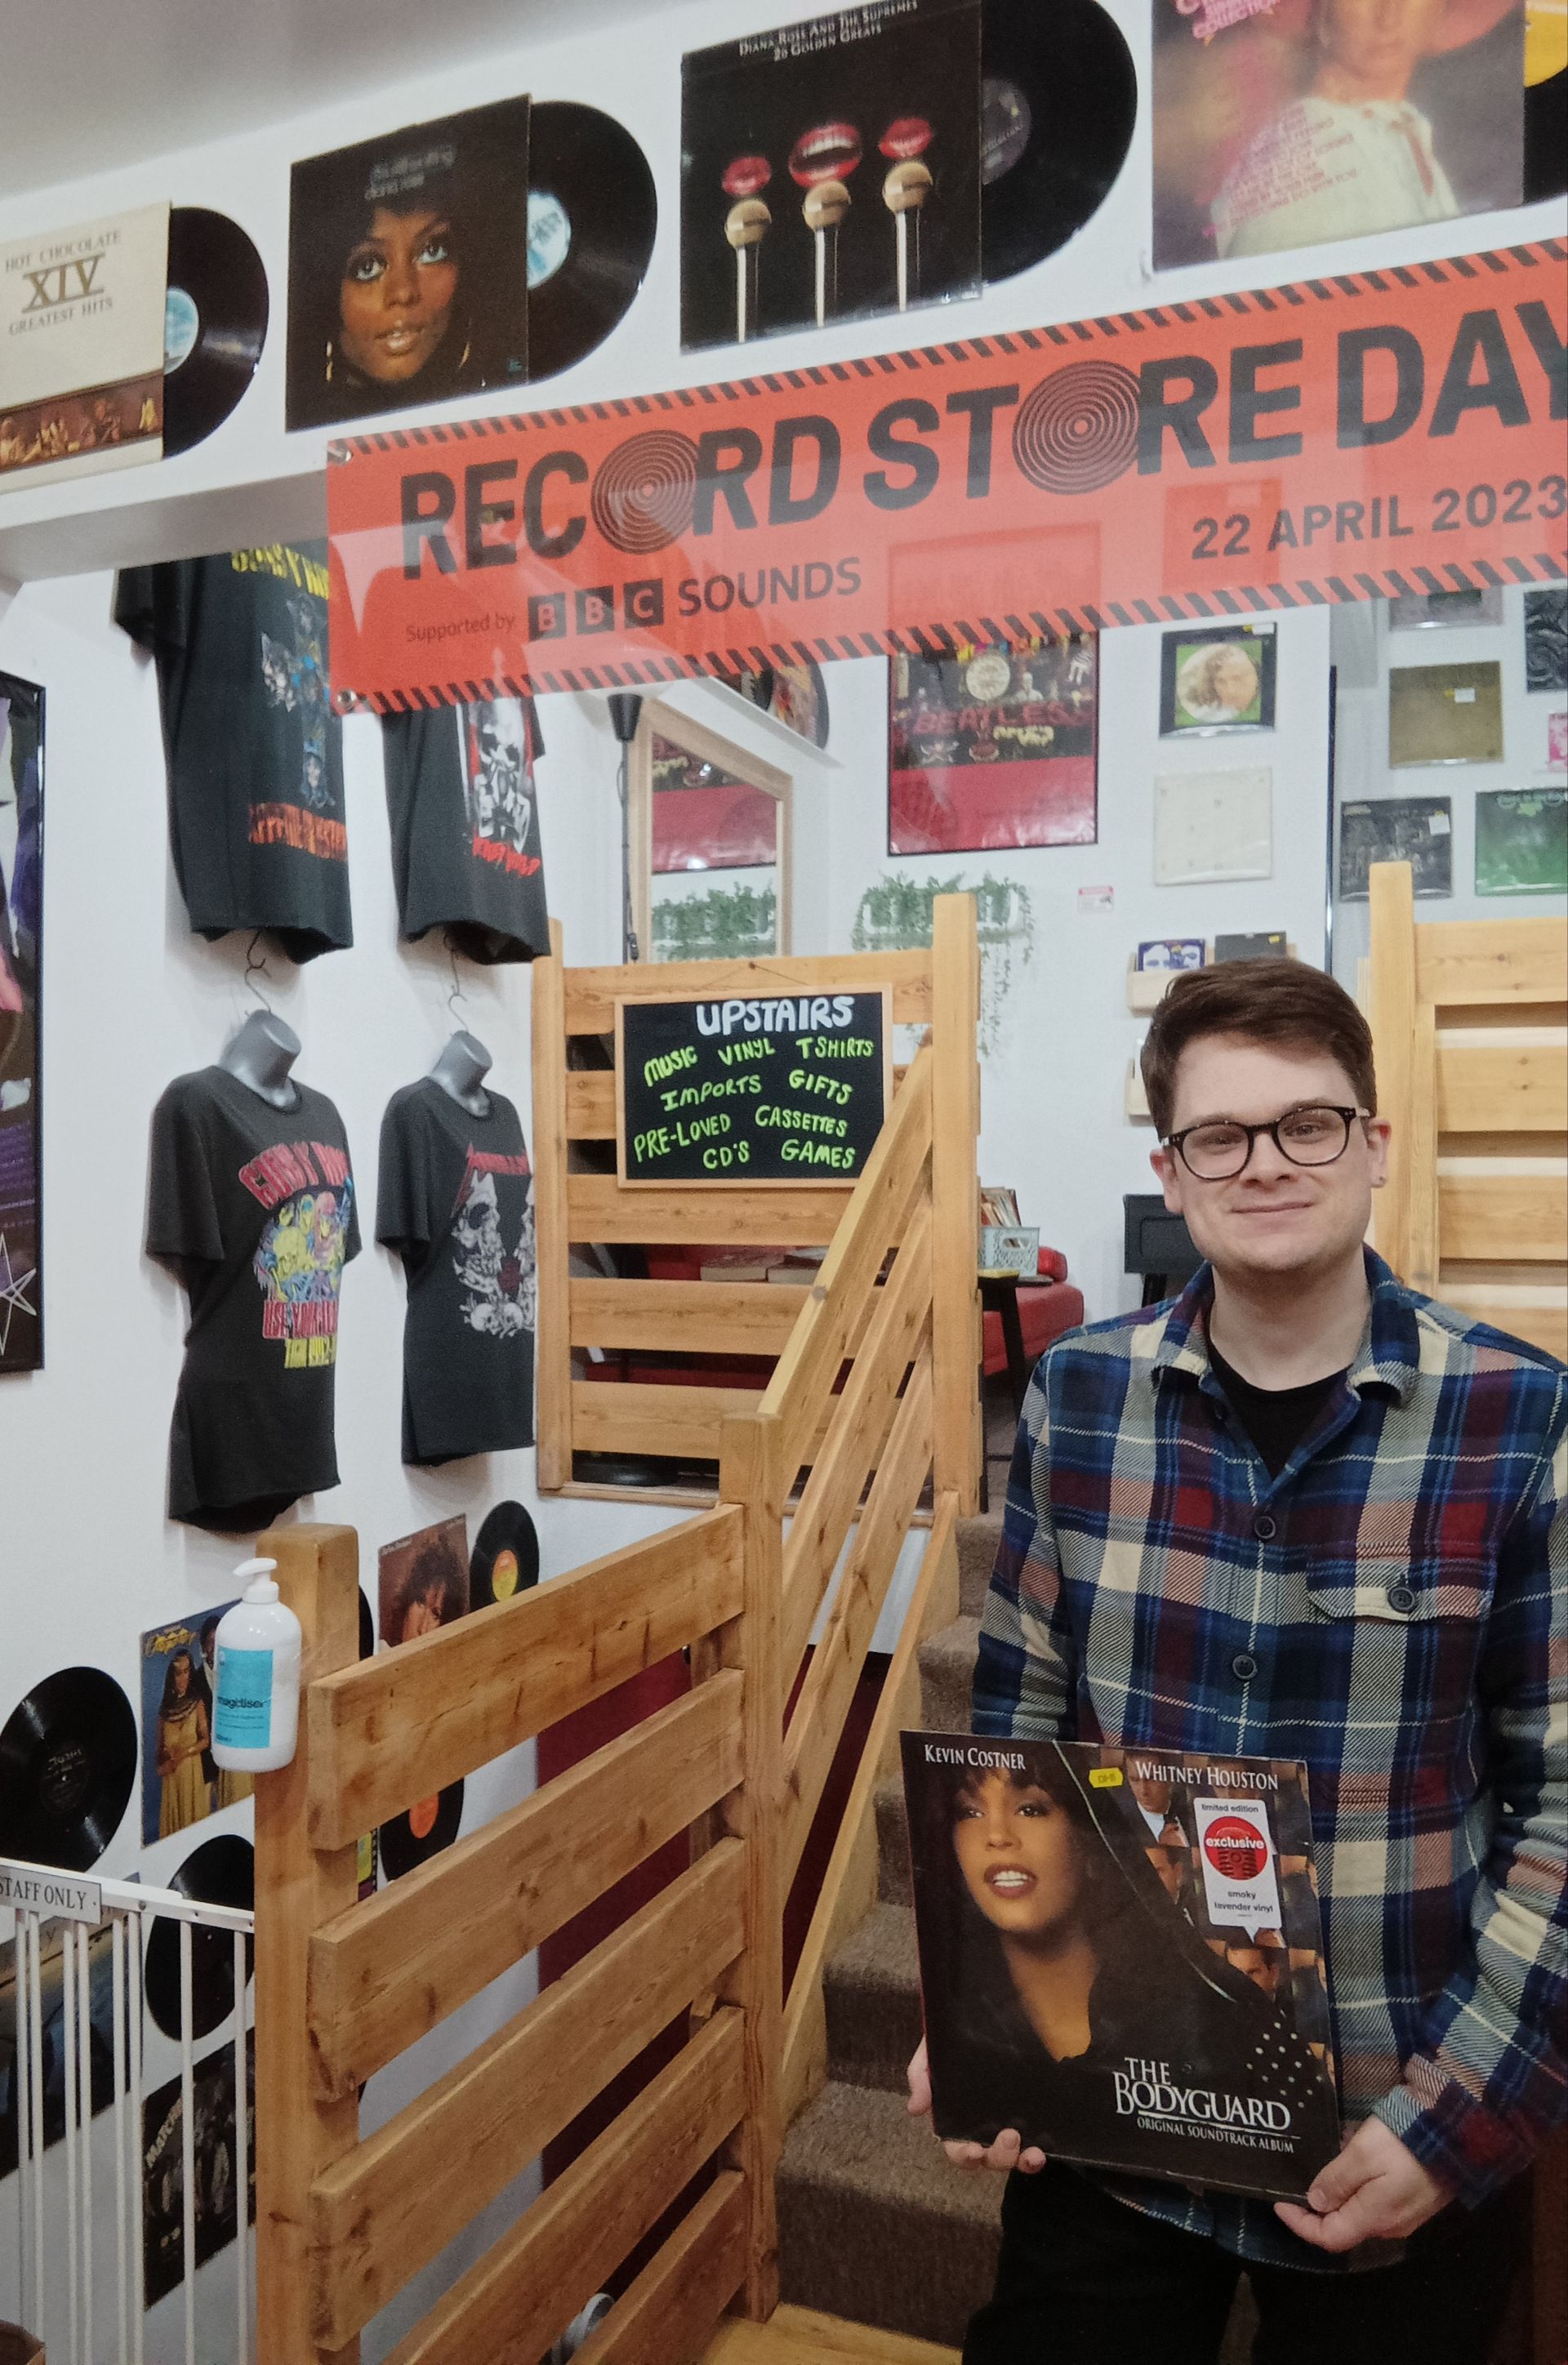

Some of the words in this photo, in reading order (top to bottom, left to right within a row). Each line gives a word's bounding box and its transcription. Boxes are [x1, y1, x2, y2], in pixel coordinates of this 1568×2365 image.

[739, 39, 775, 57] DIANA
[22, 252, 105, 314] XIV
[8, 308, 74, 336] GREATEST
[82, 296, 114, 315] HITS
[400, 415, 840, 580] RECORD
[863, 339, 1303, 510] STORE
[1192, 514, 1250, 559] 22
[1268, 496, 1413, 550] APRIL
[1432, 474, 1567, 531] 2023
[406, 614, 489, 644] Supported
[494, 612, 515, 634] by
[528, 578, 663, 640] BBC
[678, 558, 861, 617] SOUNDS
[696, 995, 855, 1036] UPSTAIRS
[644, 1045, 698, 1087] MUSIC
[718, 1038, 775, 1066] VINYL
[660, 1075, 761, 1111] IMPORTS
[789, 1070, 853, 1105] GIFTS
[634, 1113, 731, 1163] PRE-LOVED
[755, 1105, 848, 1137] CASSETTES
[703, 1141, 749, 1169] CD'S
[781, 1139, 854, 1169] GAMES
[924, 1744, 964, 1764] KEVIN
[967, 1747, 1026, 1770] COSTNER
[1135, 1761, 1202, 1784] WHITNEY
[1206, 1766, 1280, 1790] HOUSTON
[1201, 1803, 1228, 1812] limited
[1231, 1805, 1258, 1813] edition
[1205, 1836, 1264, 1850] exclusive
[44, 1885, 87, 1909] ONLY
[1214, 1902, 1250, 1911] lavender
[1254, 1904, 1273, 1913] vinyl
[1227, 1891, 1256, 1900] smoky
[1125, 2056, 1171, 2085] THE
[1112, 2071, 1291, 2131] BODYGUARD
[1137, 2117, 1185, 2136] ORIGINAL
[1187, 2124, 1256, 2148] SOUNDTRACK
[1258, 2137, 1294, 2153] ALBUM
